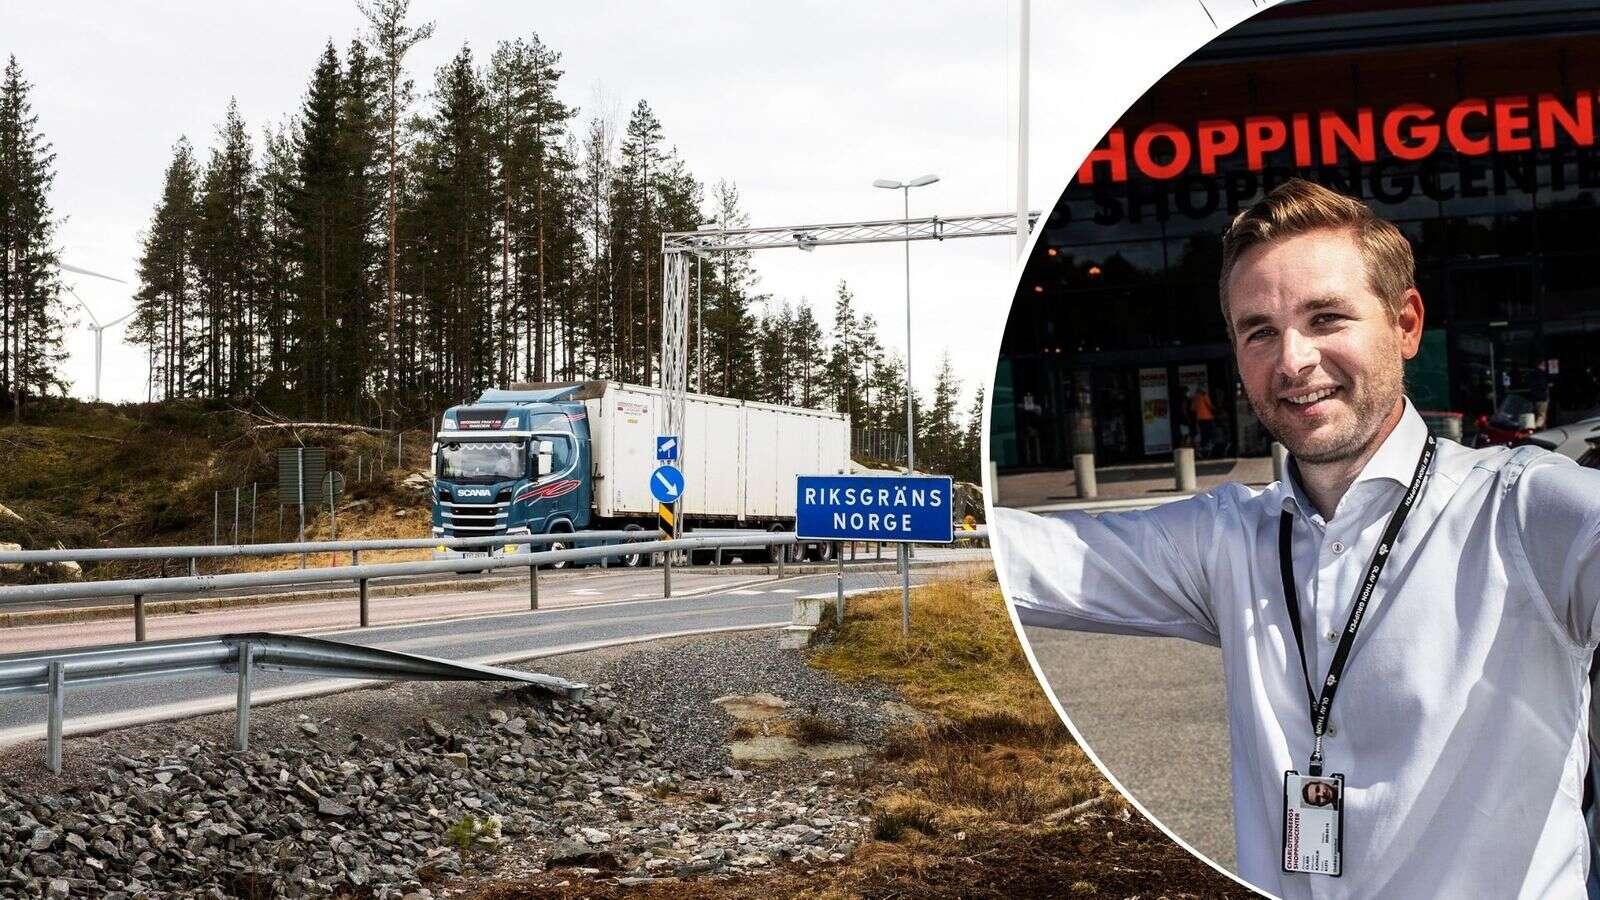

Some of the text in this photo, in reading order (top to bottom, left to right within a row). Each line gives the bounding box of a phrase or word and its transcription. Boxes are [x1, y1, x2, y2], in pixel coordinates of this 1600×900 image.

[1078, 91, 1600, 185] HOPPINGCEN
[457, 489, 492, 497] SCANIA
[805, 486, 942, 508] RIKSGRÄNS
[833, 512, 912, 532] NORGE
[1348, 565, 1380, 633] OLAV THON GRUPPEN
[1320, 697, 1330, 715] OLAV
[1293, 812, 1301, 870] SHOPPINGCENTER
